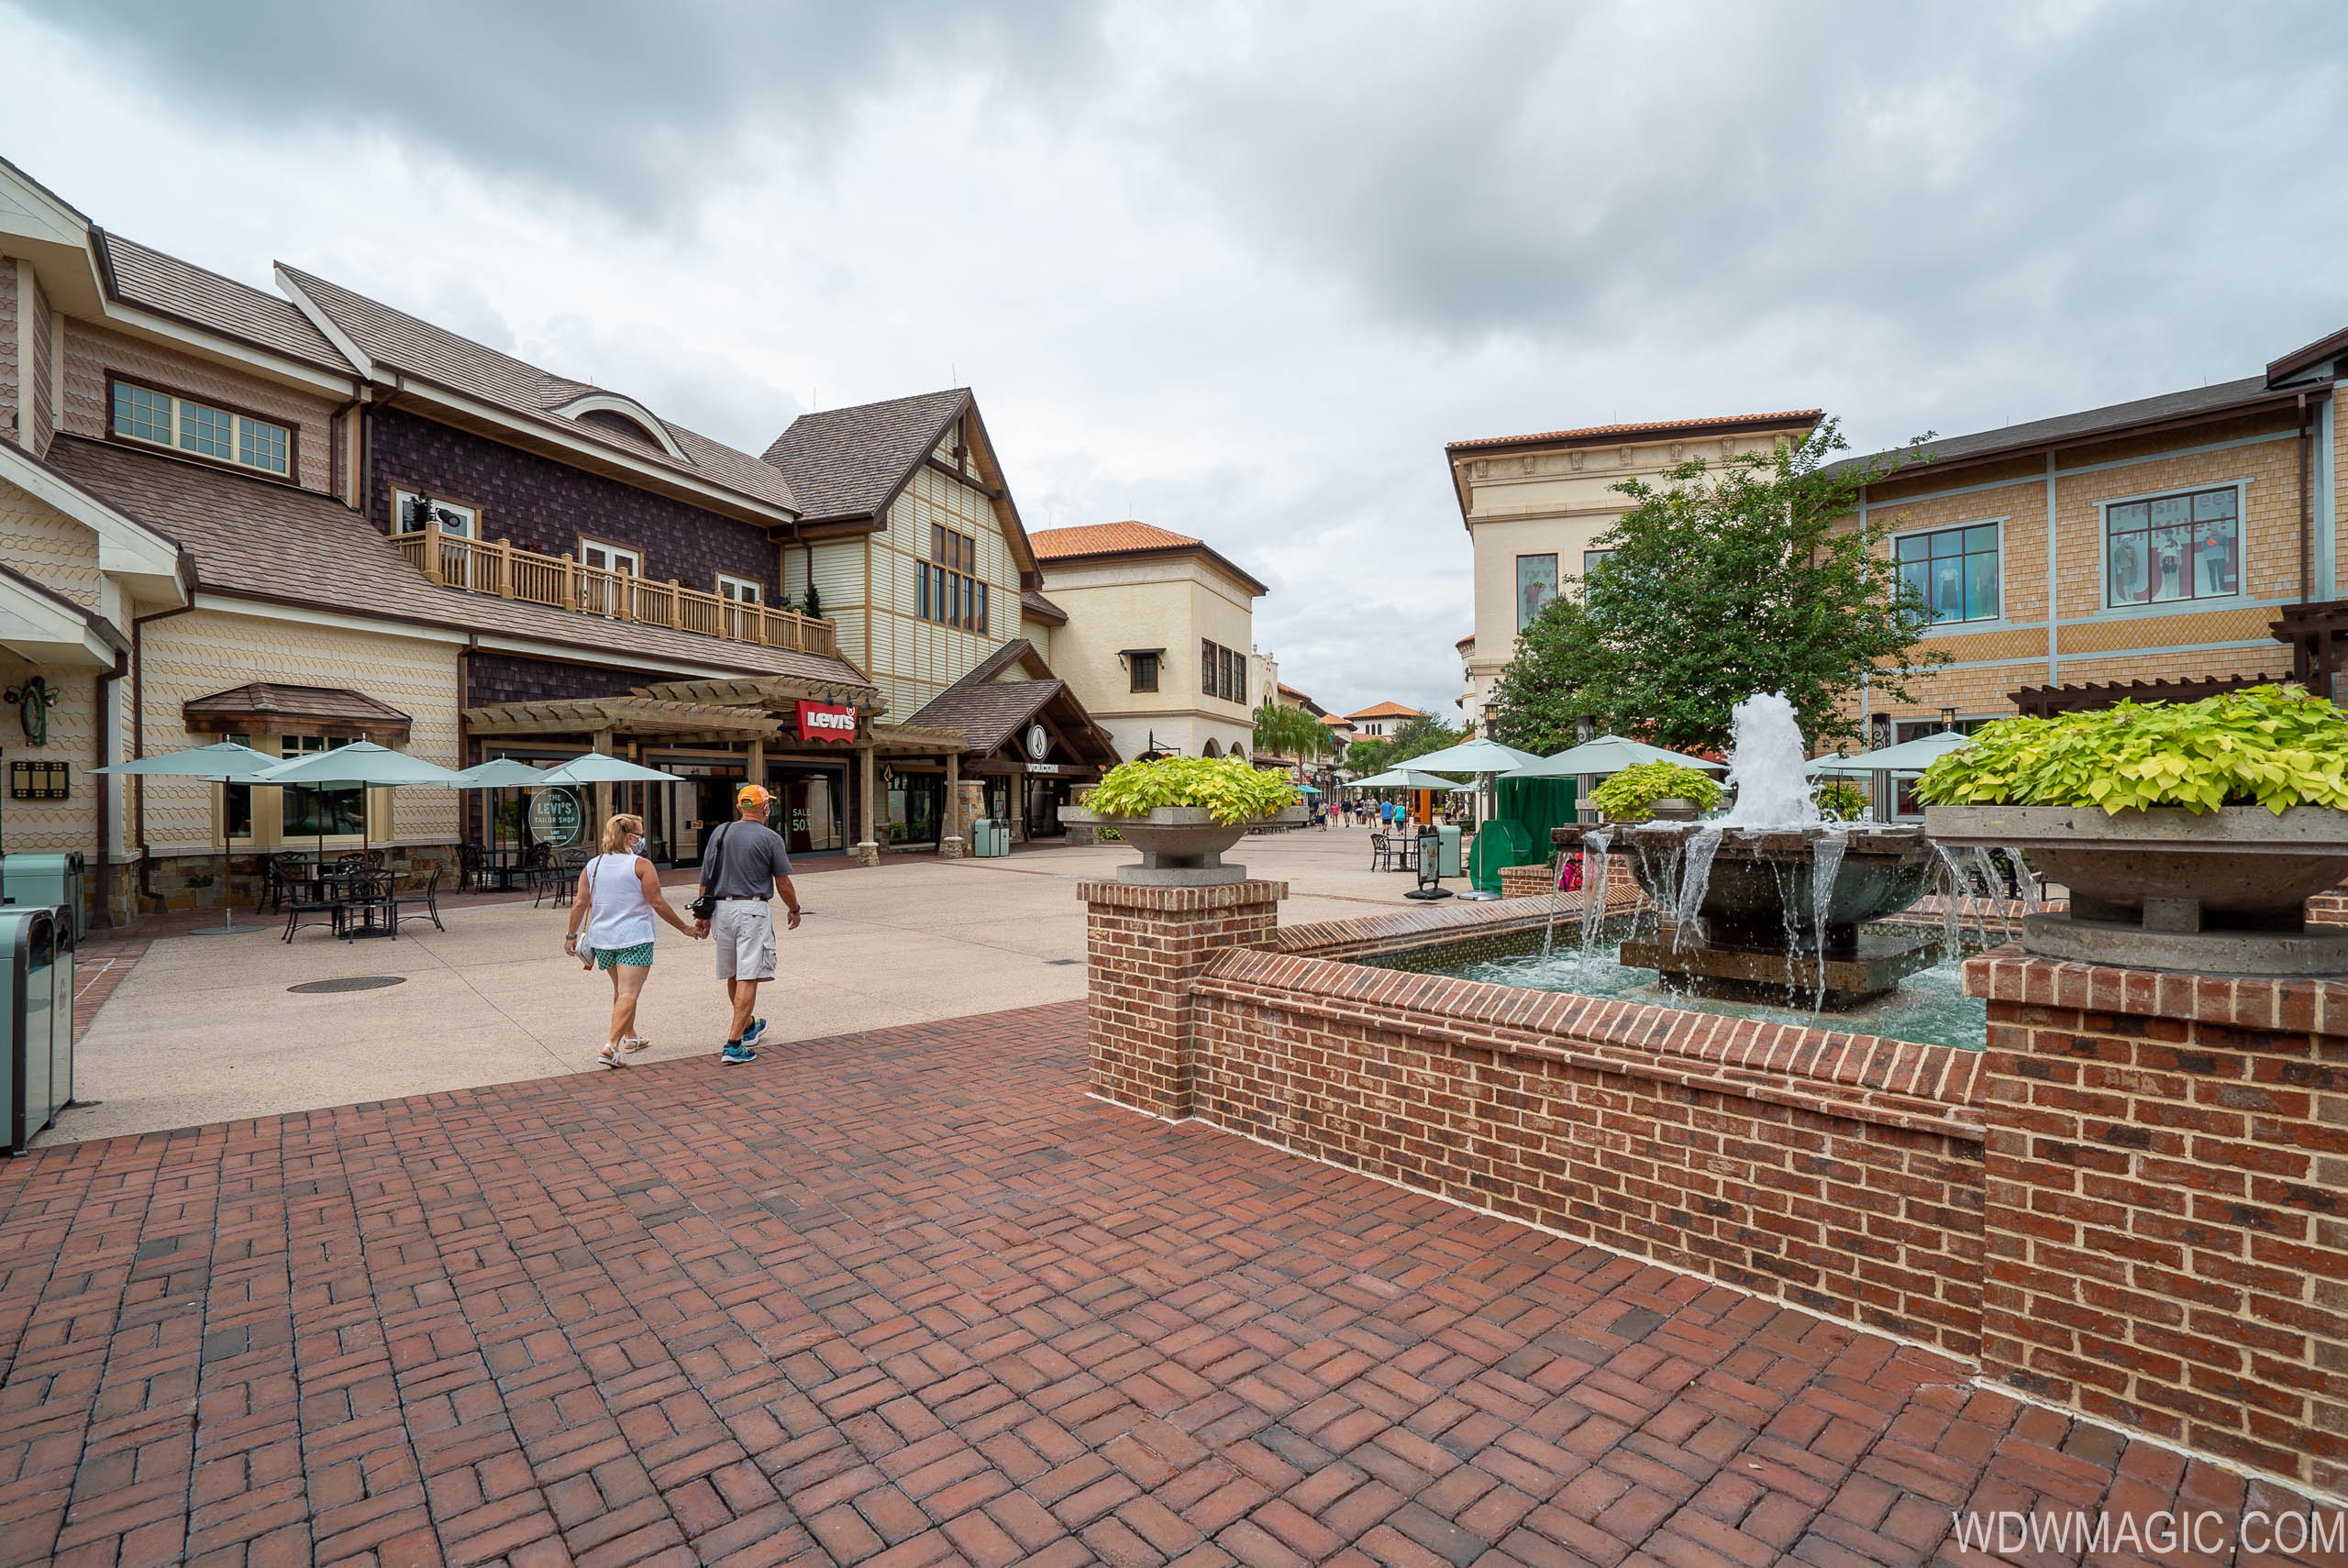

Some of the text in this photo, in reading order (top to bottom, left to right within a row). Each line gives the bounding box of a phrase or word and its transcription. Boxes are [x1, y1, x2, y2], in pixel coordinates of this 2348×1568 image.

[1027, 763, 1058, 773] VOLCOM
[537, 802, 571, 814] LEVI'S
[792, 808, 811, 816] SALE
